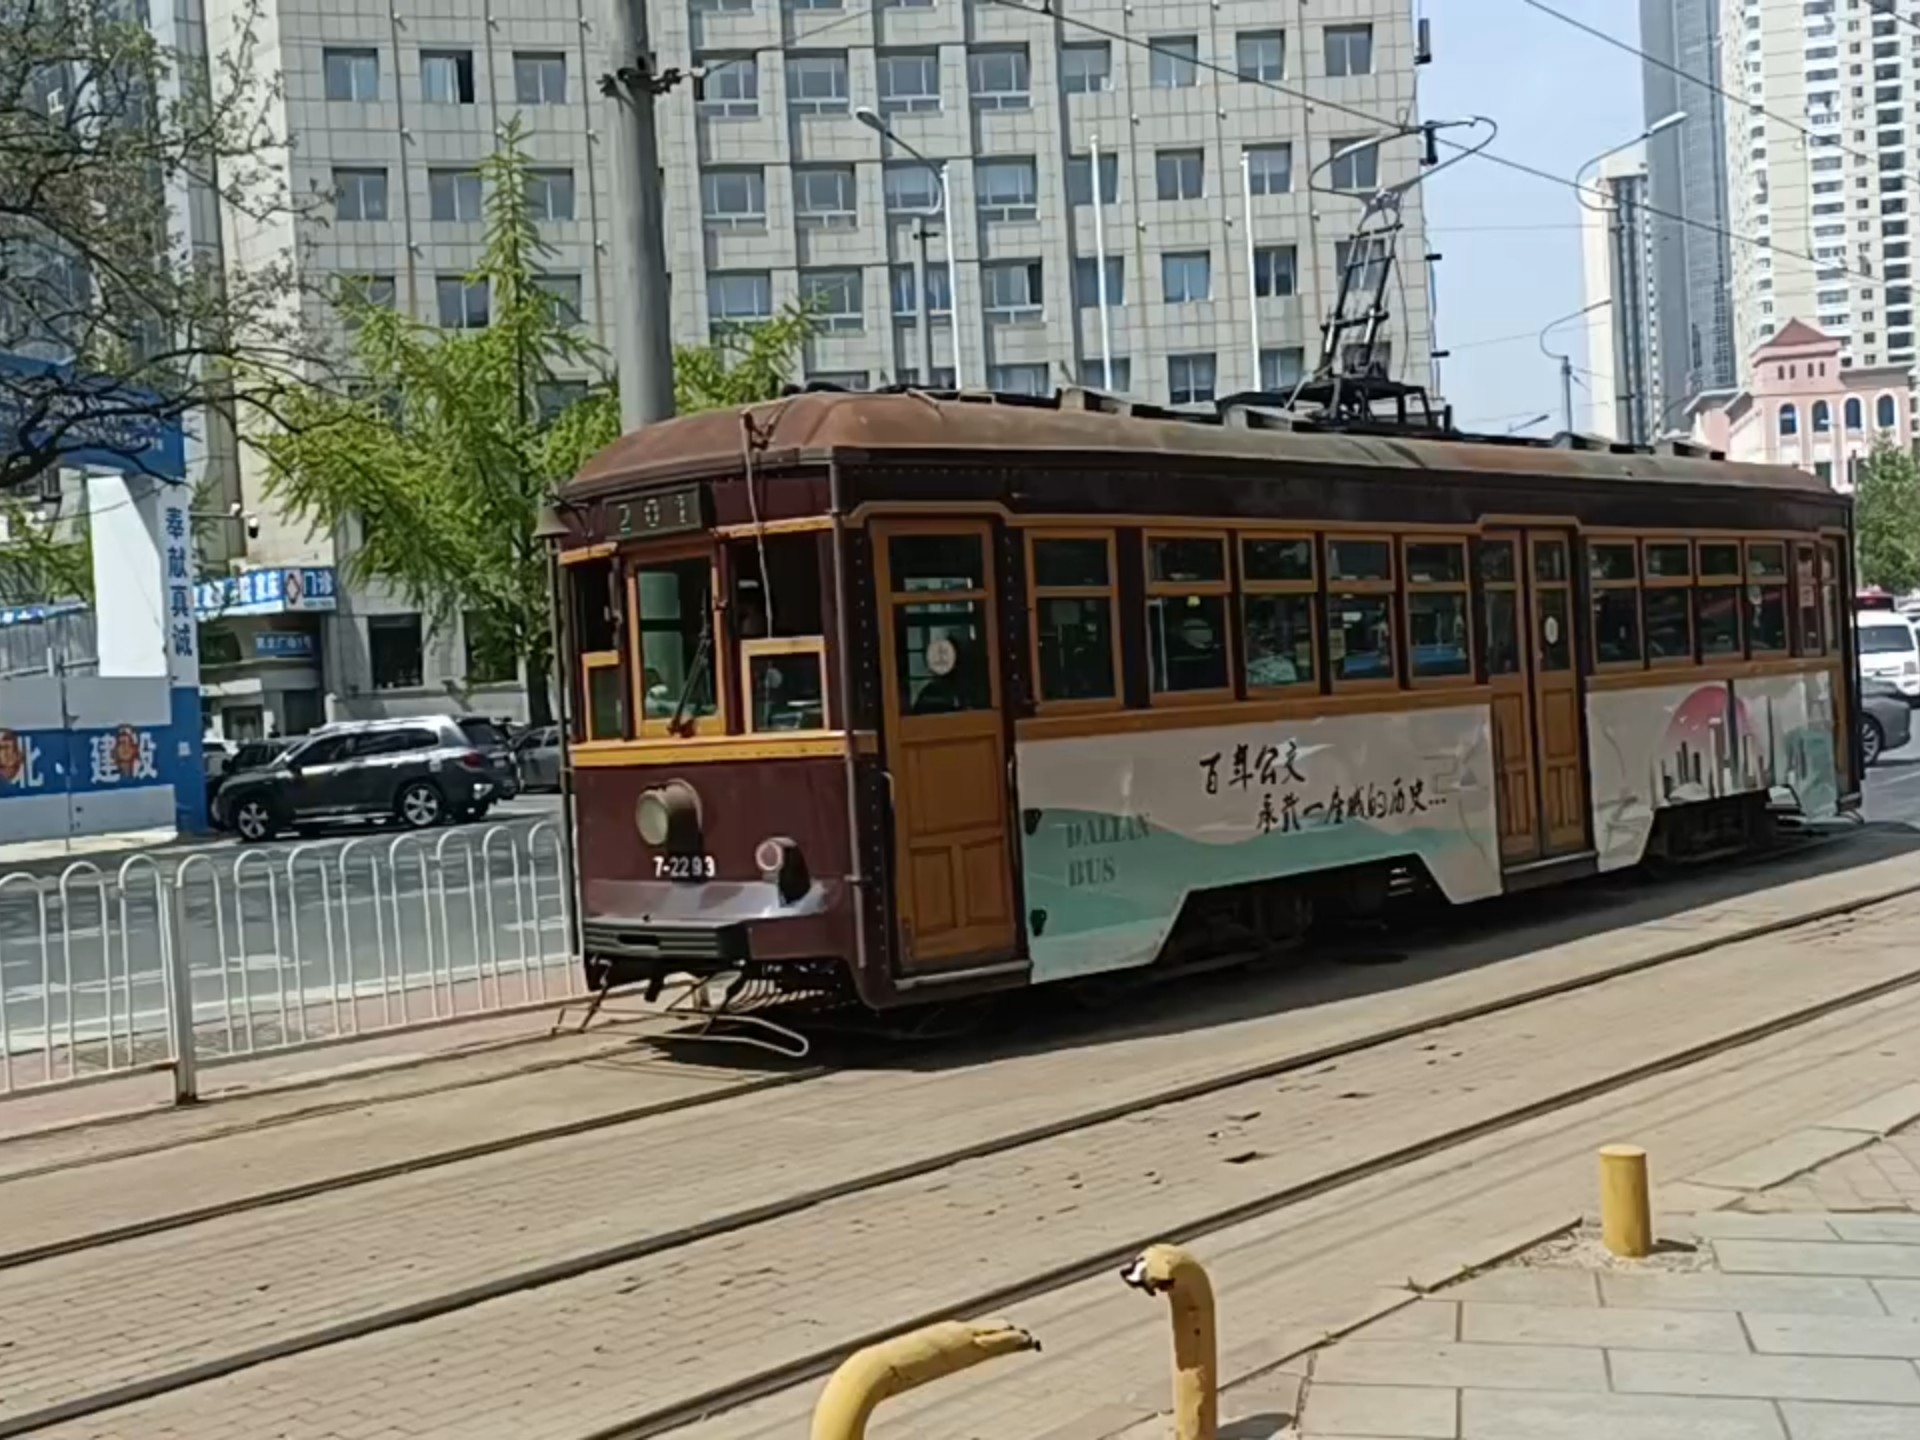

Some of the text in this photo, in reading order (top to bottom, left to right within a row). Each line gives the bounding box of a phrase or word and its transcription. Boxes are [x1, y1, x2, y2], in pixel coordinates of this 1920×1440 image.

[618, 494, 687, 535] 201
[165, 507, 193, 656] 奉献真诚
[1067, 813, 1150, 849] DALIAN
[653, 855, 716, 877] 7-2293
[1069, 857, 1116, 887] BUS
